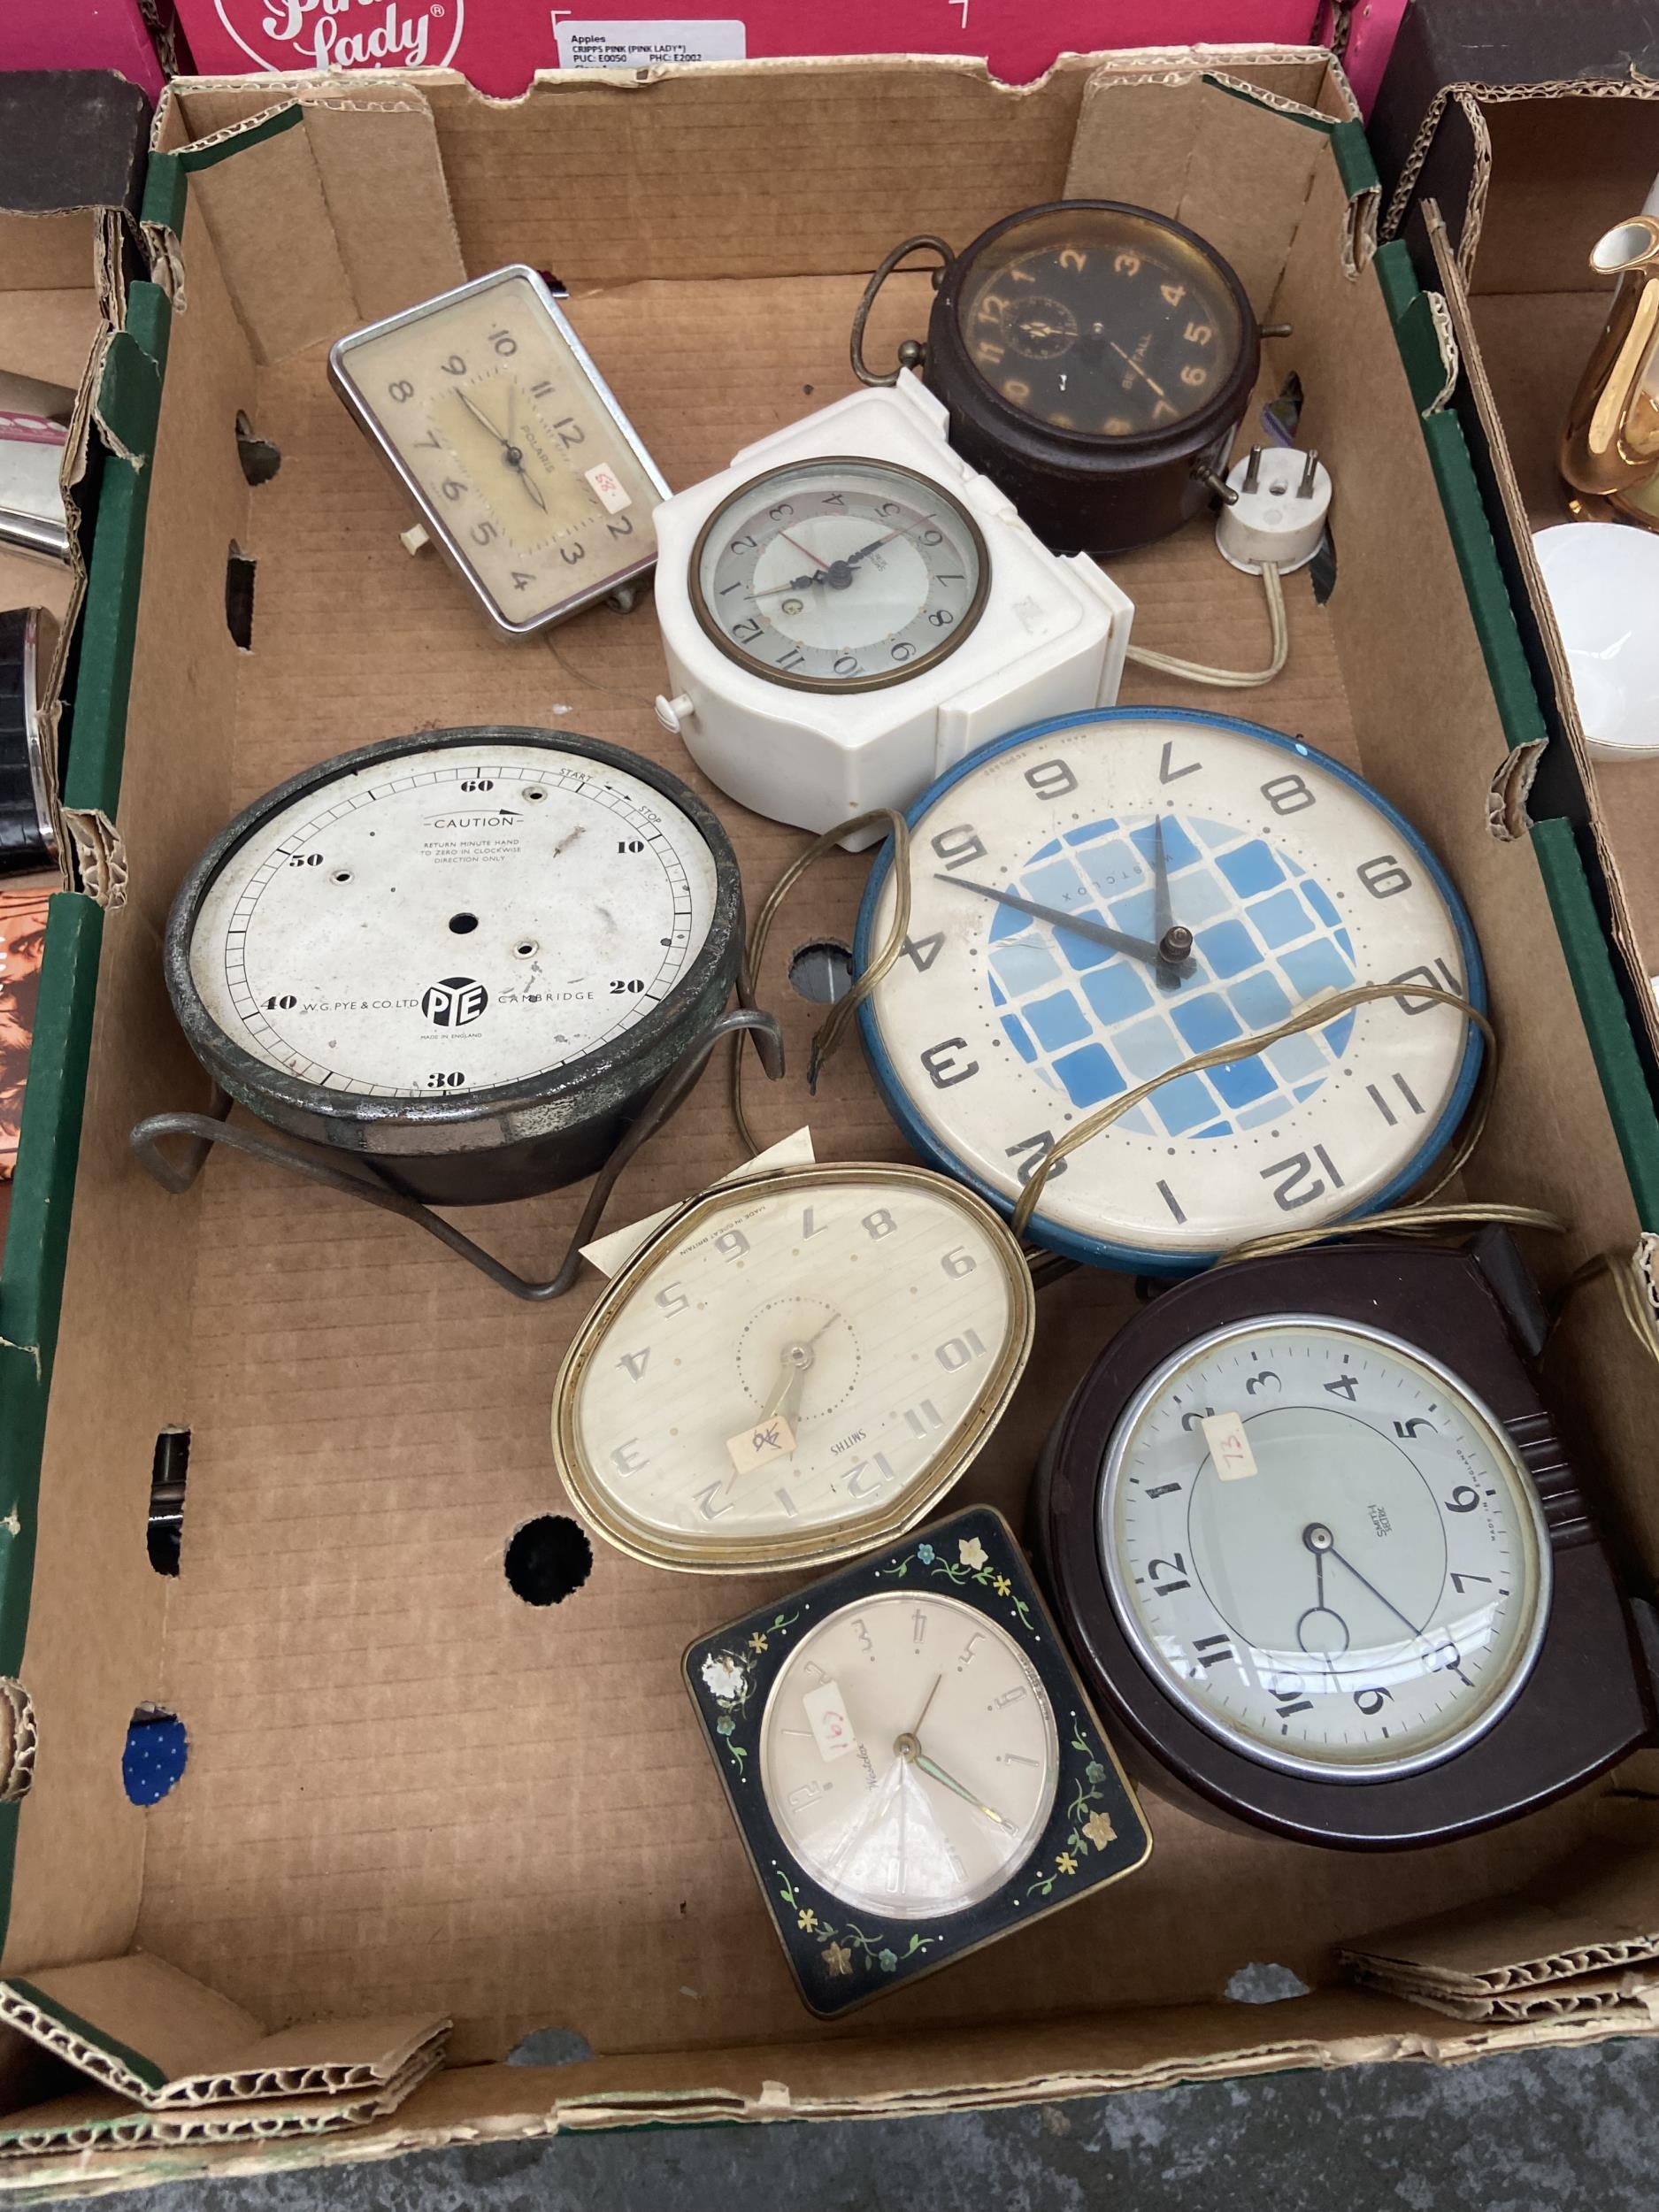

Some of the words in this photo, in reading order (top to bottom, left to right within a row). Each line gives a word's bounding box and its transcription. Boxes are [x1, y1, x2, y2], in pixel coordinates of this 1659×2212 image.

[571, 35, 606, 43] Apples
[573, 54, 596, 63] PUC:
[598, 54, 626, 63] E0050
[1059, 250, 1087, 273] 2
[1114, 254, 1141, 277] 3
[1161, 283, 1187, 306] 4
[977, 295, 1010, 324] 12
[488, 329, 518, 357] 10
[1183, 322, 1213, 346] 5
[978, 341, 1005, 365] 11
[441, 355, 467, 376] 9
[1180, 365, 1207, 386] 6
[388, 380, 414, 403] 8
[530, 381, 555, 398] 11
[1153, 398, 1179, 419] 7
[414, 431, 441, 451] 7
[554, 417, 585, 449] 12
[520, 425, 555, 473] POLARIS
[442, 479, 467, 502] 6
[821, 493, 845, 506] 4
[769, 503, 795, 522] 3
[874, 503, 901, 518] 5
[470, 522, 497, 546] 5
[606, 516, 633, 540] 2
[918, 530, 943, 547] 6
[561, 542, 585, 565] 3
[730, 535, 757, 556] 2
[511, 572, 537, 591] 4
[719, 581, 741, 595] 1
[935, 574, 965, 588] 7
[928, 610, 954, 627] 8
[732, 618, 764, 645] 12
[776, 647, 805, 671] 11
[891, 642, 917, 661] 9
[833, 655, 865, 679] 10
[559, 767, 594, 783] START
[1159, 741, 1202, 785] 7
[460, 780, 495, 793] 60
[1024, 758, 1079, 800] 6
[1260, 773, 1317, 816] 8
[434, 817, 514, 828] CAUTION
[638, 805, 662, 824] STOP
[618, 840, 645, 854] 10
[931, 824, 987, 870] 5
[288, 852, 325, 868] 50
[1356, 855, 1412, 899] 9
[898, 931, 946, 972] 4
[498, 991, 595, 1003] CAMBRIDGE
[610, 978, 645, 995] 20
[1388, 957, 1463, 1017] 10
[260, 995, 297, 1010] 40
[360, 1001, 369, 1010] &
[422, 977, 488, 1026] PYE
[919, 1037, 980, 1089] 3
[427, 1071, 465, 1088] 30
[1365, 1073, 1426, 1126] 11
[1005, 1130, 1069, 1187] 2
[1260, 1144, 1345, 1212] 12
[745, 1206, 766, 1220] MADE
[1156, 1179, 1188, 1225] 1
[710, 1224, 734, 1240] GREAT
[802, 1205, 828, 1240] 7
[861, 1207, 897, 1241] 8
[680, 1237, 709, 1256] BRITAIN
[714, 1228, 751, 1263] 6
[941, 1246, 978, 1280] 9
[655, 1281, 690, 1319] 5
[934, 1328, 987, 1373] 10
[615, 1346, 651, 1383] 4
[1246, 1370, 1283, 1395] 3
[1323, 1374, 1359, 1402] 4
[902, 1398, 945, 1440] 11
[1393, 1417, 1439, 1439] 5
[830, 1428, 867, 1455] SMITHS
[610, 1437, 651, 1479] 3
[1456, 1449, 1481, 1487] ENGLAND
[841, 1451, 895, 1499] 12
[692, 1480, 735, 1521] 2
[774, 1486, 799, 1519] 1
[1145, 1482, 1182, 1500] 1
[1444, 1486, 1480, 1513] 6
[1482, 1502, 1489, 1512] IN
[1367, 1504, 1386, 1538] SMITH
[1486, 1518, 1496, 1541] MADE
[1148, 1553, 1191, 1597] 12
[1450, 1572, 1493, 1594] 7
[1192, 1633, 1233, 1669] 11
[1268, 1671, 1315, 1718] 10
[1353, 1686, 1395, 1715] 9
[856, 1742, 879, 1792] Westclox
